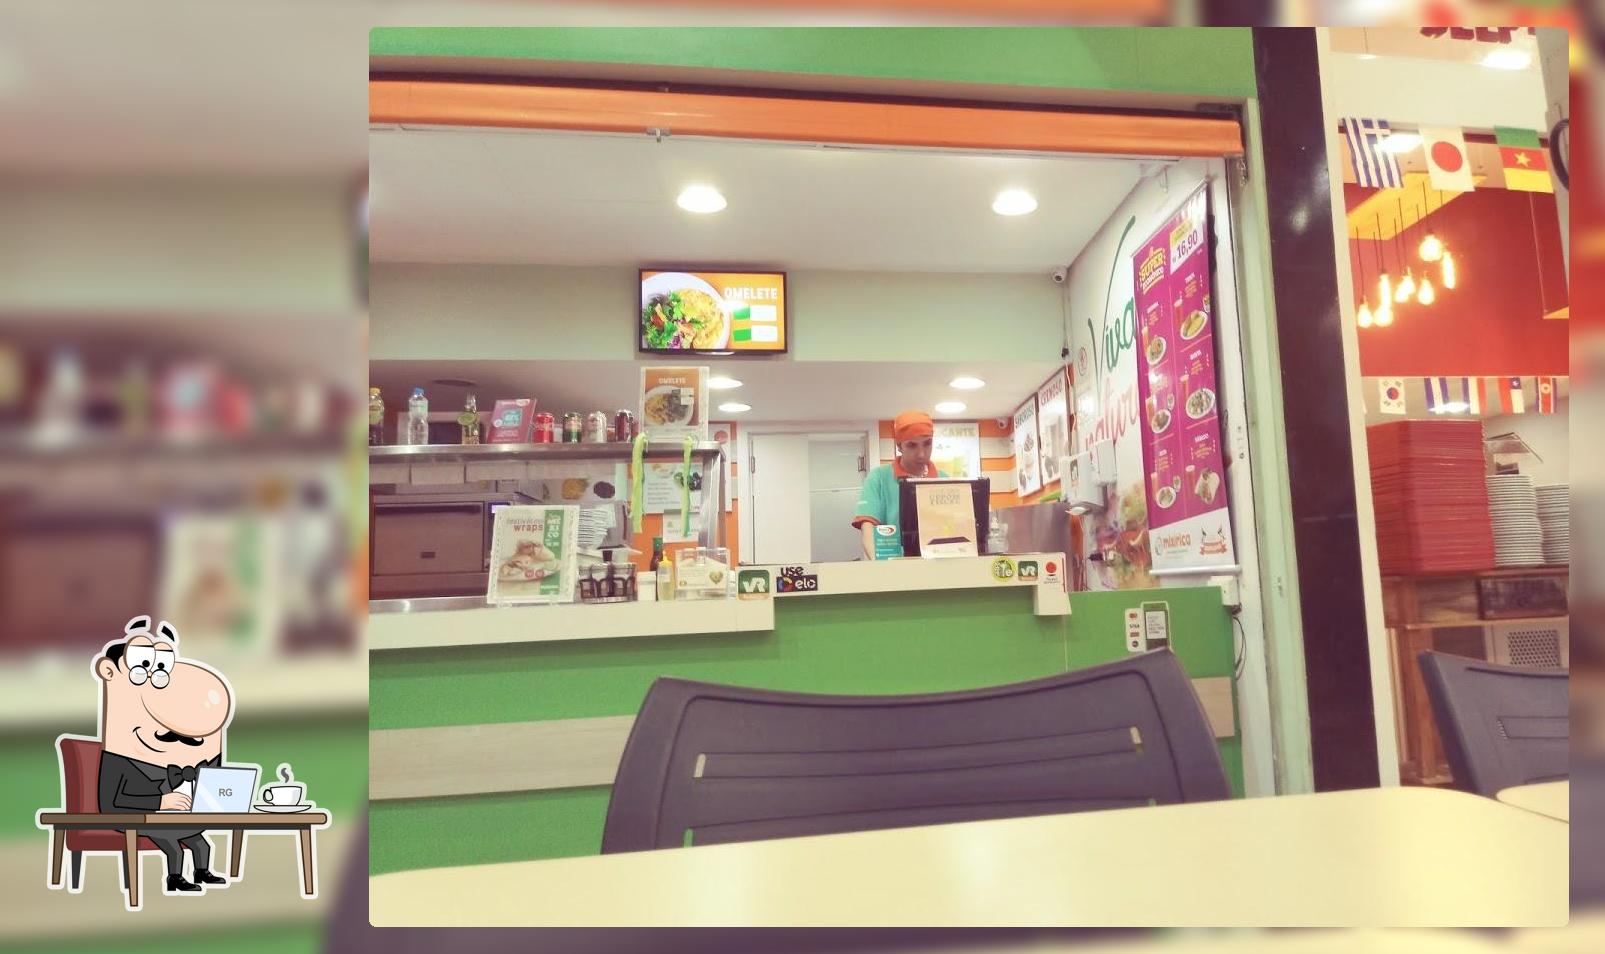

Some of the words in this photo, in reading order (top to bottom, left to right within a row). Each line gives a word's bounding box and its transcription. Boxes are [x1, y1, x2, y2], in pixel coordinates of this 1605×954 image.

[1177, 229, 1198, 260] 16,90
[723, 286, 778, 300] OMELETE
[513, 523, 544, 533] wraps
[780, 566, 804, 576] use
[742, 576, 766, 593] VR
[794, 577, 816, 589] elo
